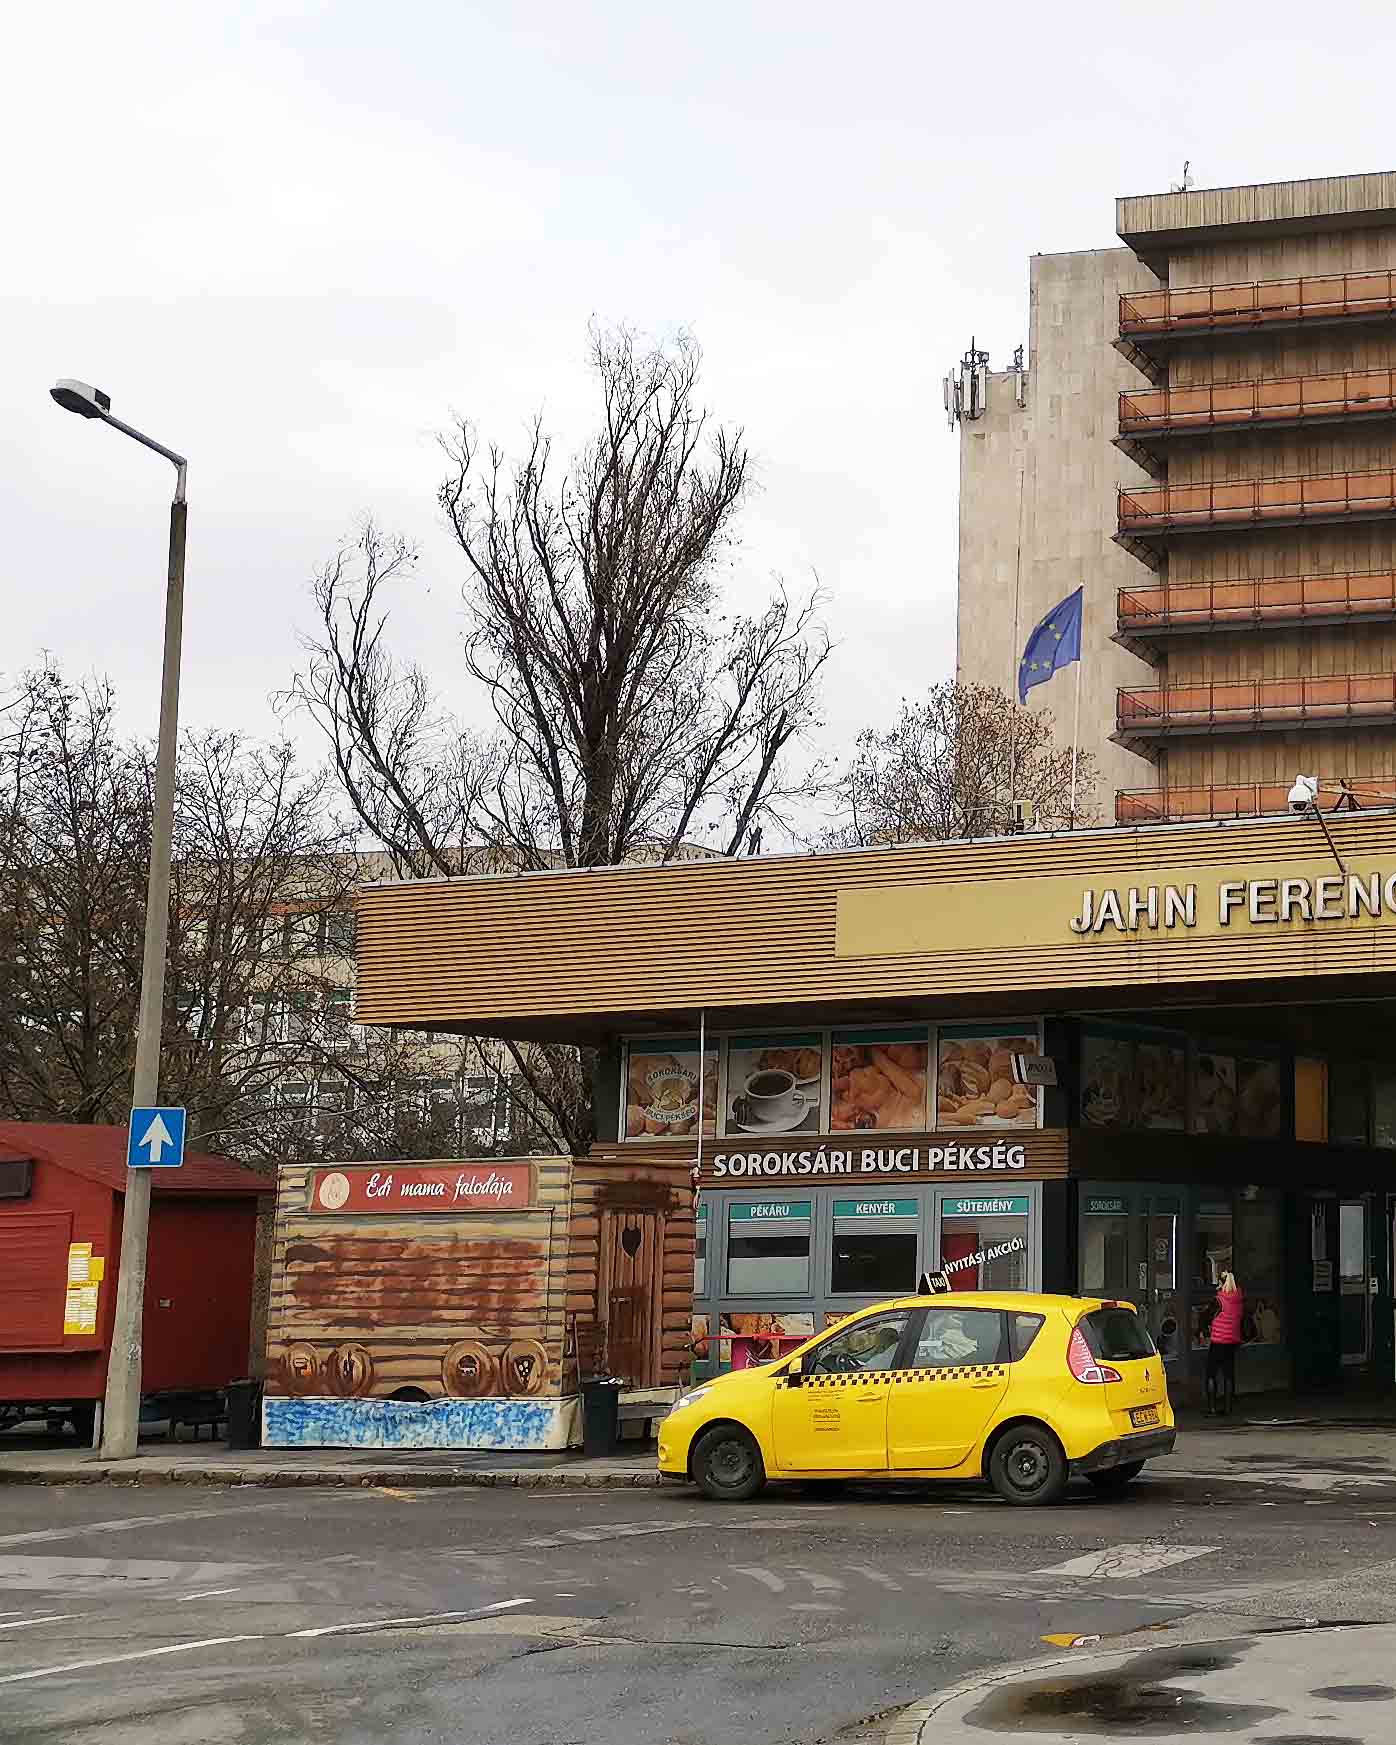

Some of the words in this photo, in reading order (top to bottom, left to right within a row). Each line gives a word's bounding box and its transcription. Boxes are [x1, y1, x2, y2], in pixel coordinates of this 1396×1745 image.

[1069, 882, 1197, 934] JAHN
[713, 1145, 852, 1177] SOROKSÁRI
[861, 1148, 919, 1172] BUCI
[929, 1140, 1025, 1170] PÉKSÉG
[366, 1172, 393, 1197] Edi
[400, 1181, 445, 1197] mama
[451, 1171, 512, 1201] falodája
[750, 1203, 790, 1217] PÉKÁRU
[855, 1200, 896, 1214] KENYÉR
[955, 1198, 1014, 1214] SÜTEMÉNY
[944, 1249, 986, 1275] NYITÁSI
[931, 1276, 946, 1289] TAXI
